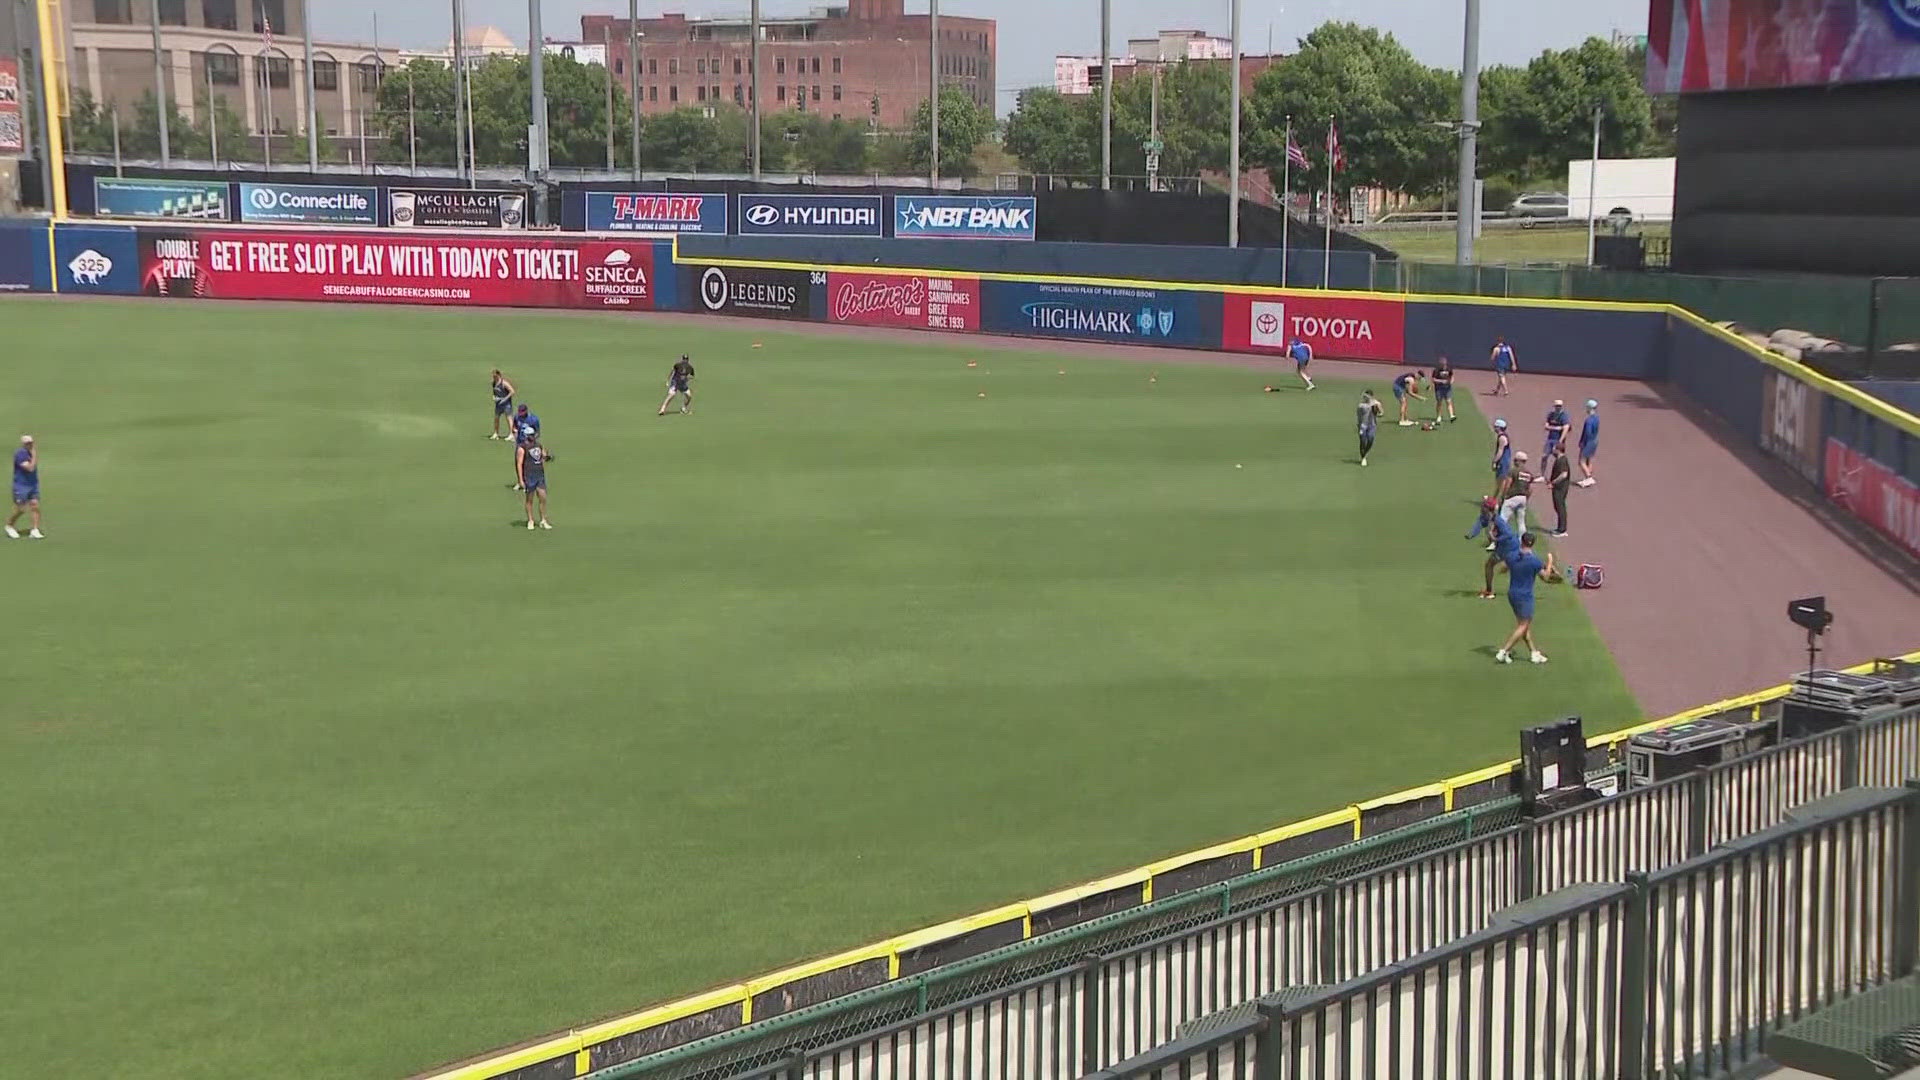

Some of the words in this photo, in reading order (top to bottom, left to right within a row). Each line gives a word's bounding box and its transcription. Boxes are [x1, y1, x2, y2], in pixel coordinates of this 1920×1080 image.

[279, 192, 368, 210] ConnectLife
[417, 195, 497, 207] McCULLAGH
[612, 195, 703, 221] T-MARK
[784, 207, 875, 225] HYUNDAI
[921, 207, 969, 227] NBT
[967, 208, 1032, 229] BANK
[156, 239, 199, 260] DOUBLE
[78, 259, 105, 272] 325
[162, 260, 196, 279] PLAY!
[210, 241, 243, 272] GET
[248, 241, 290, 273] FREE
[294, 243, 336, 275] SLOT
[341, 244, 383, 276] PLAY
[388, 245, 434, 277] WITH
[437, 247, 509, 279] TODAY'S
[513, 248, 579, 281] TICKET!
[585, 267, 647, 284] SENECA
[810, 271, 826, 285] 364
[323, 285, 471, 299] SENECABUFFALOCREEKCASINO.COM
[586, 284, 620, 294] BUFFALO
[620, 285, 647, 295] CREEK
[730, 283, 796, 303] LEGENDS
[928, 278, 953, 291] MAKING
[603, 297, 630, 305] CASINO
[835, 277, 925, 320] Costanzo's
[928, 291, 970, 305] SANDWICHES
[928, 304, 948, 315] GREAT
[928, 316, 948, 328] SINCE
[949, 317, 965, 329] 1933
[1032, 307, 1131, 334] HIGHMARK
[1291, 317, 1372, 340] TOYOTA
